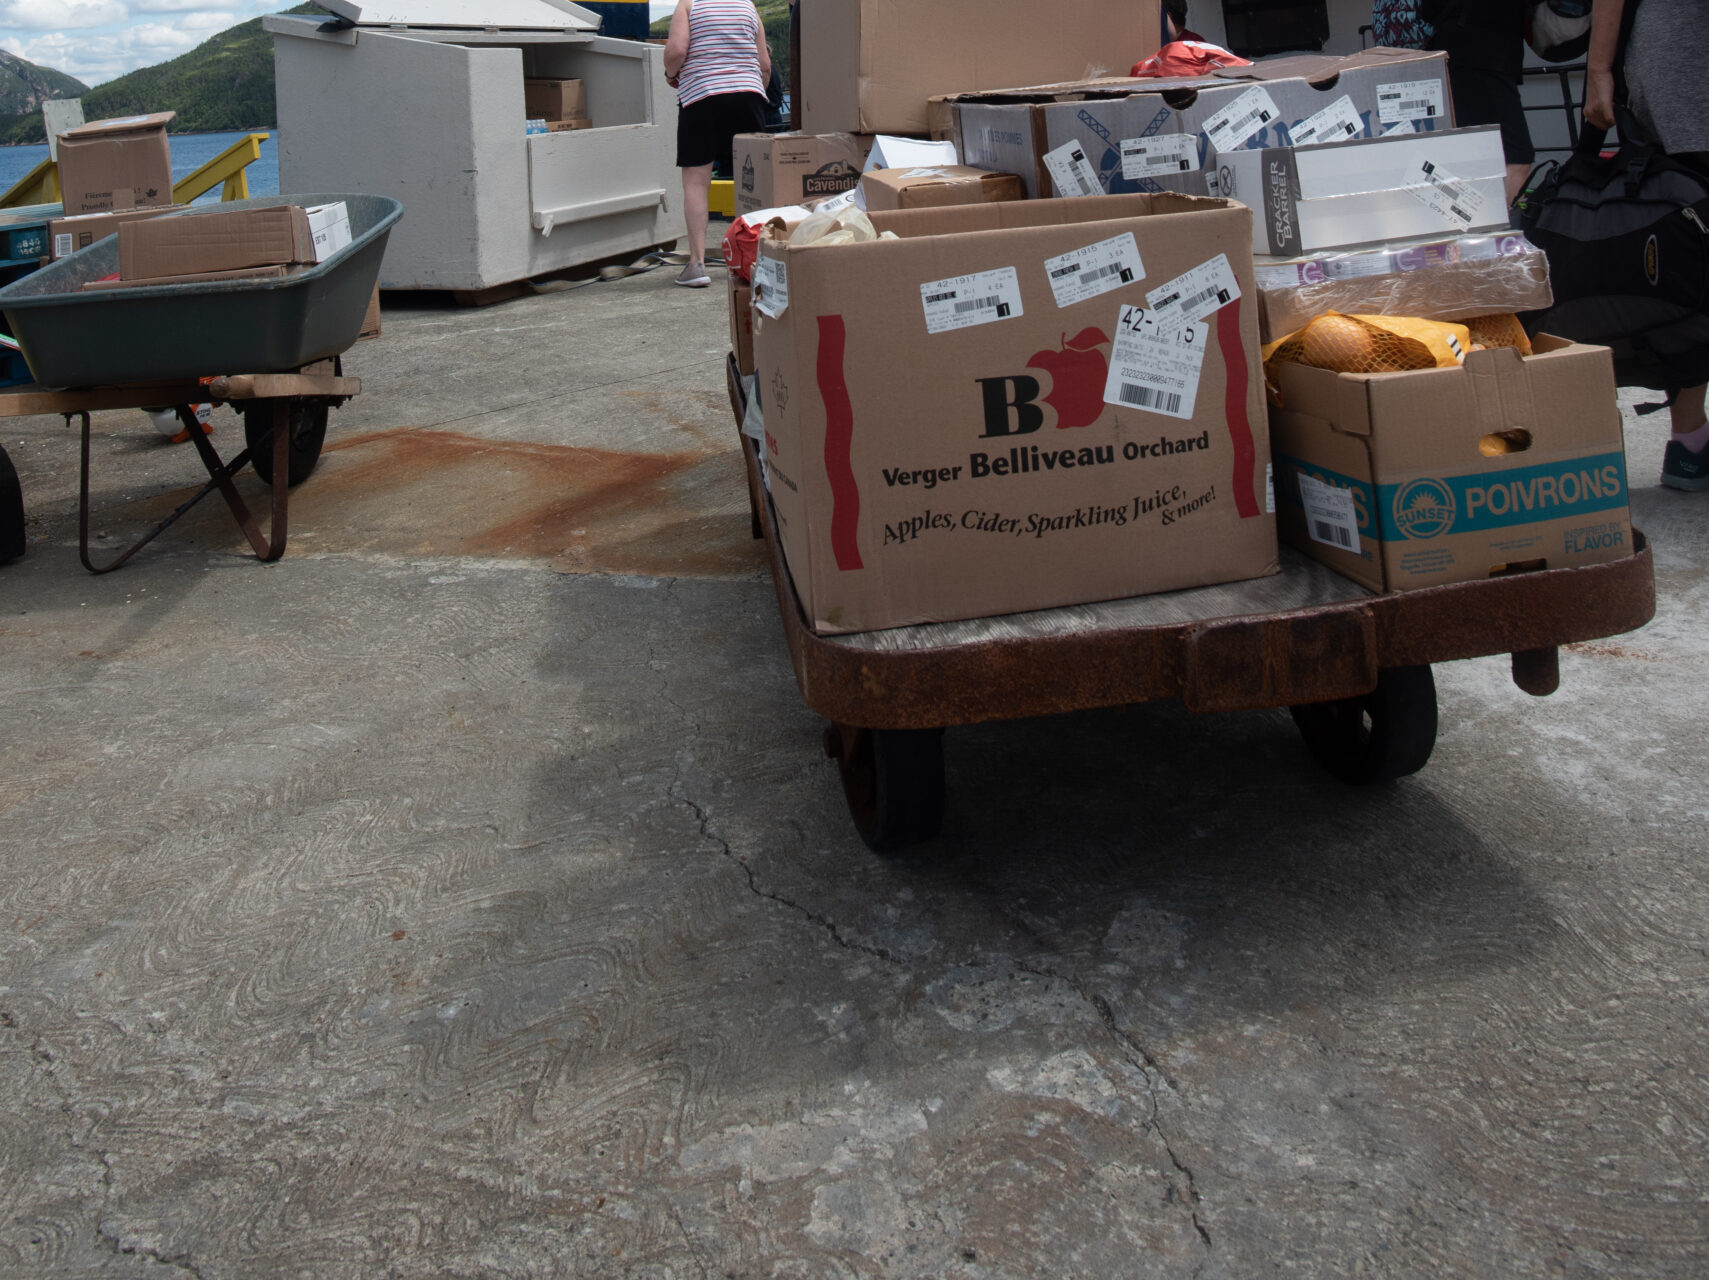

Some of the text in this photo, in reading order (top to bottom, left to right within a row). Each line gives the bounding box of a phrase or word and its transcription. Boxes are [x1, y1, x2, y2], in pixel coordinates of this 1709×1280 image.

[1270, 161, 1285, 248] CRACKER
[1279, 165, 1293, 239] BARREL
[1060, 246, 1098, 262] 42-1915
[937, 275, 976, 288] 42-1917
[1160, 272, 1193, 293] 42-1911
[975, 375, 1044, 438] B
[882, 431, 1209, 489] Verger Belliveau Orchard
[1161, 485, 1216, 525] & more!
[1465, 466, 1621, 519] POIVRONS
[883, 484, 1187, 545] Apples, Cider, Sparkling Juice,
[1397, 507, 1455, 527] SUNSET
[1563, 524, 1607, 539] INSPIRED
[1564, 531, 1624, 555] FLAVOR
